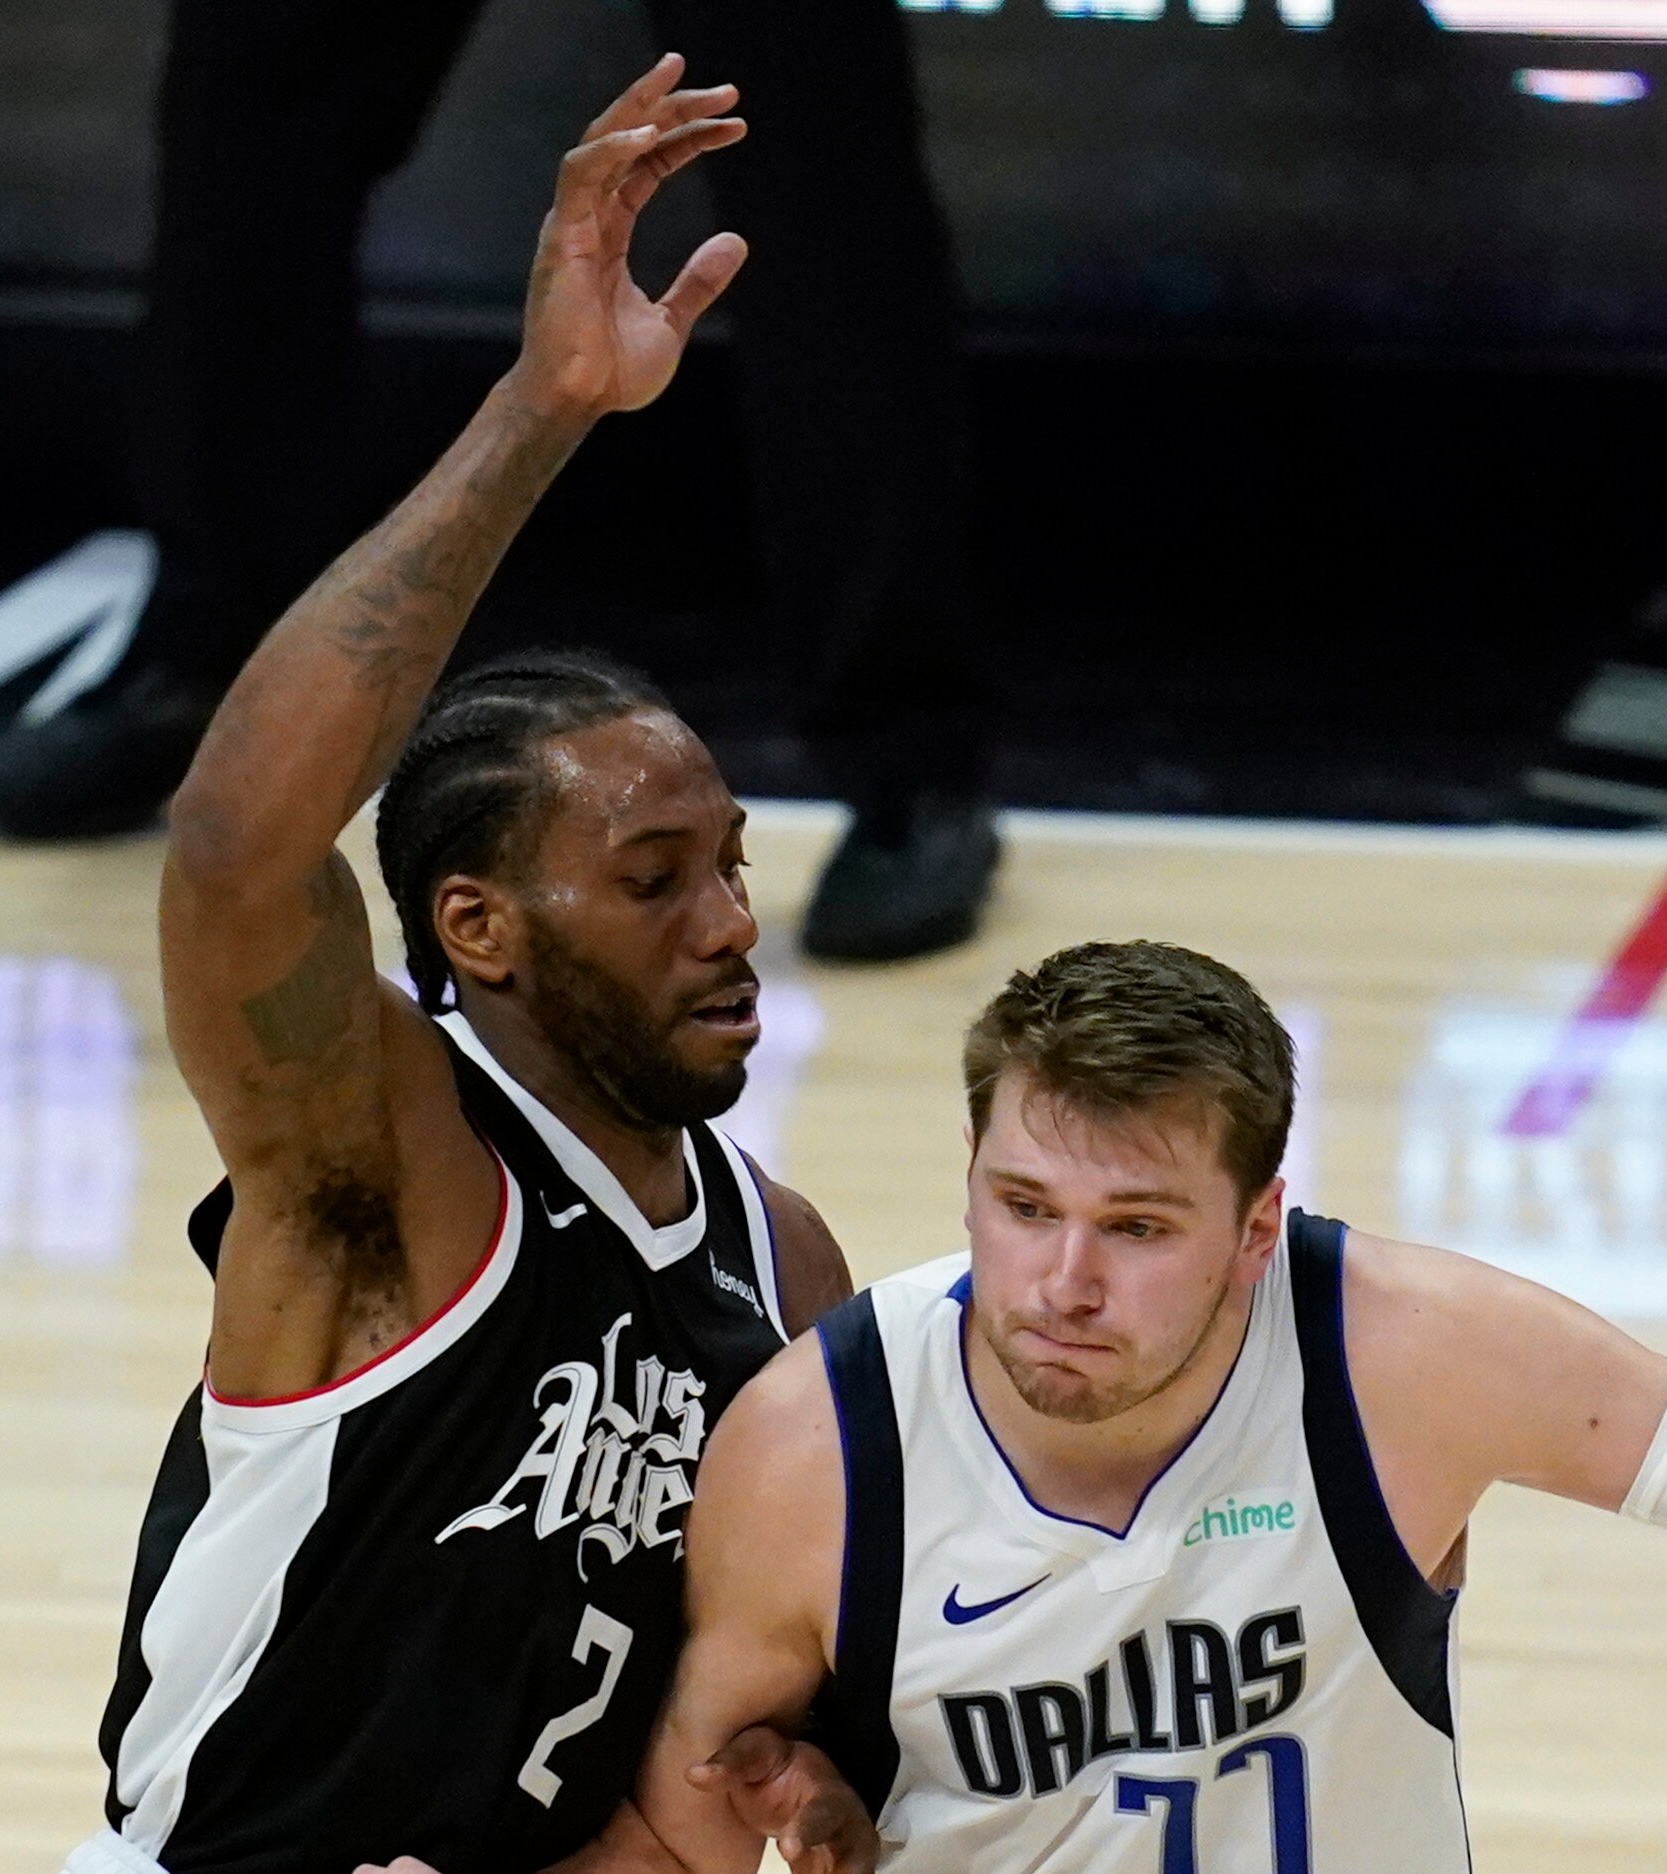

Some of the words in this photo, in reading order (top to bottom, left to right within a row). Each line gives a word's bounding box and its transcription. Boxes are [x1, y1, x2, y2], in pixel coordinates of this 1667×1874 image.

[435, 1361, 694, 1583] Ange
[1183, 1497, 1296, 1547] chime
[517, 1602, 634, 1809] 2
[936, 1604, 1308, 1800] DALLAS
